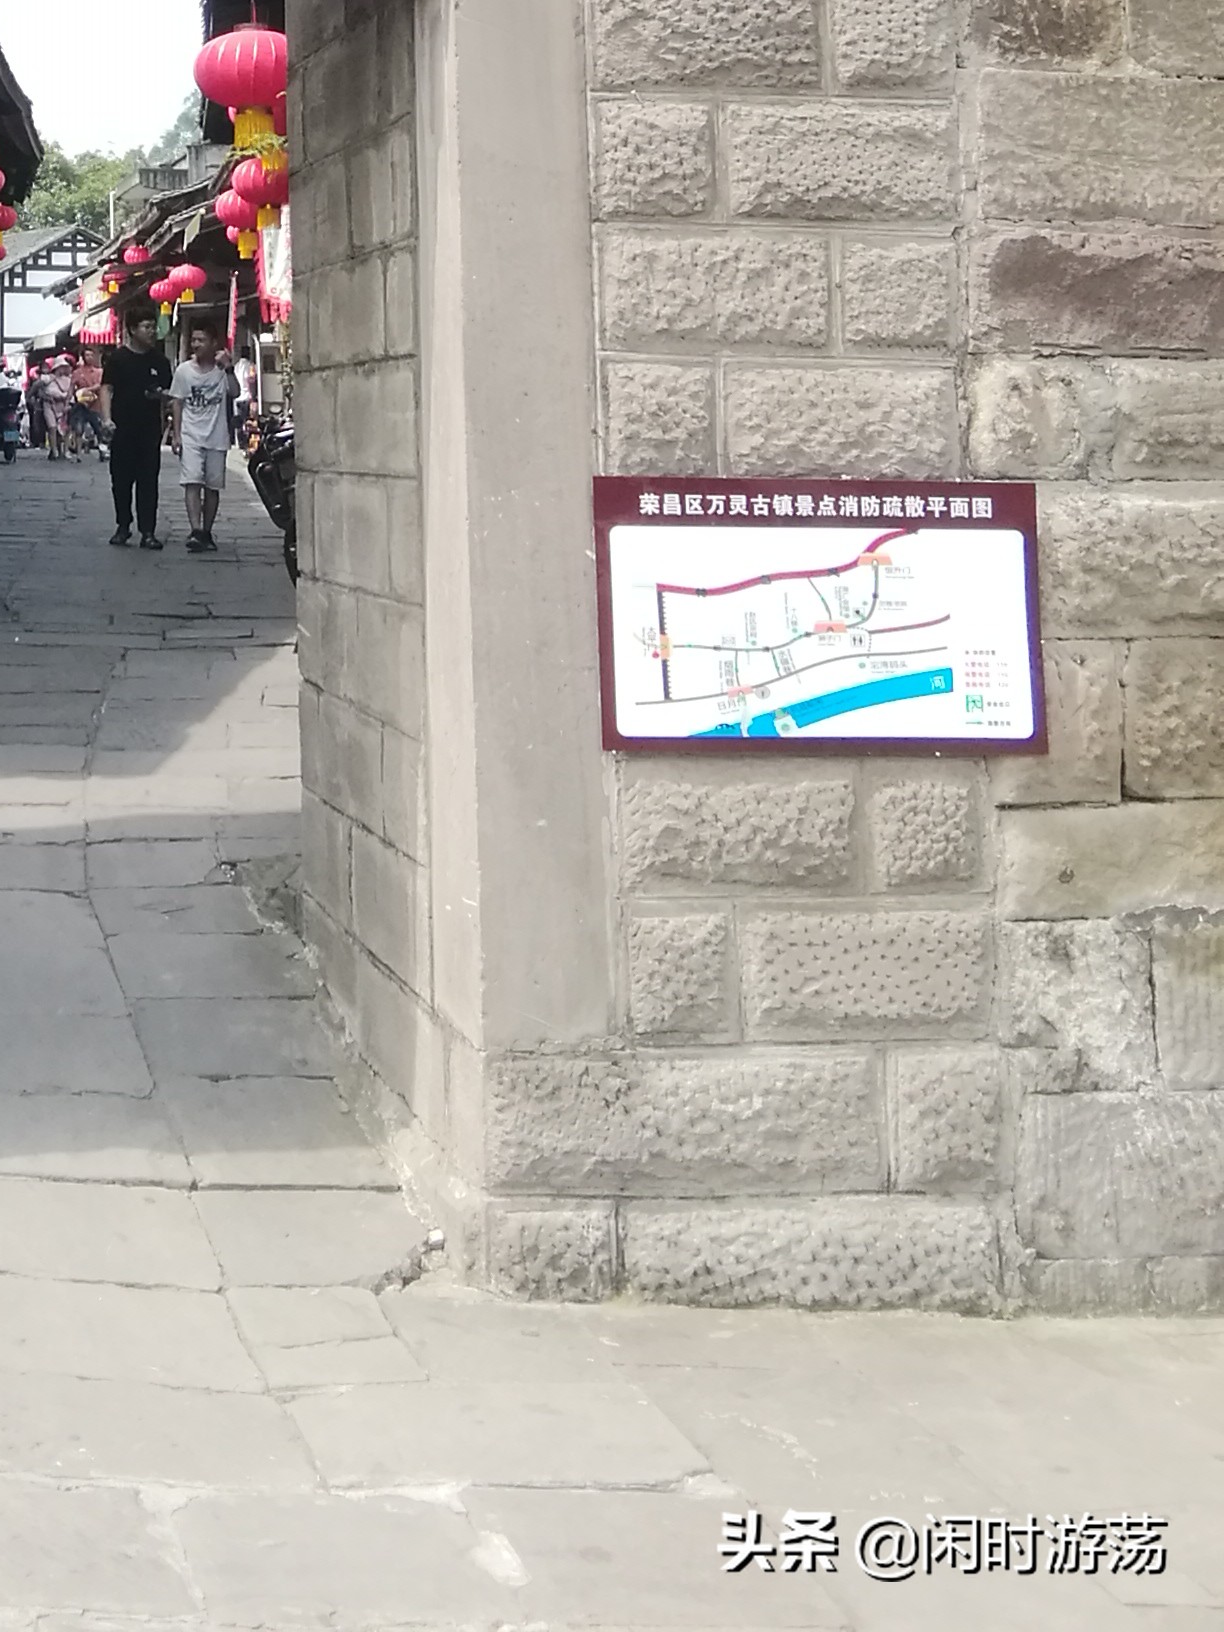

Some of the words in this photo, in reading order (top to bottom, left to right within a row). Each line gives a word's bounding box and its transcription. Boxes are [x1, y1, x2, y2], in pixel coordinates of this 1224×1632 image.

[639, 493, 993, 520] 荣昌区万灵古镇景点消防疏散平面图
